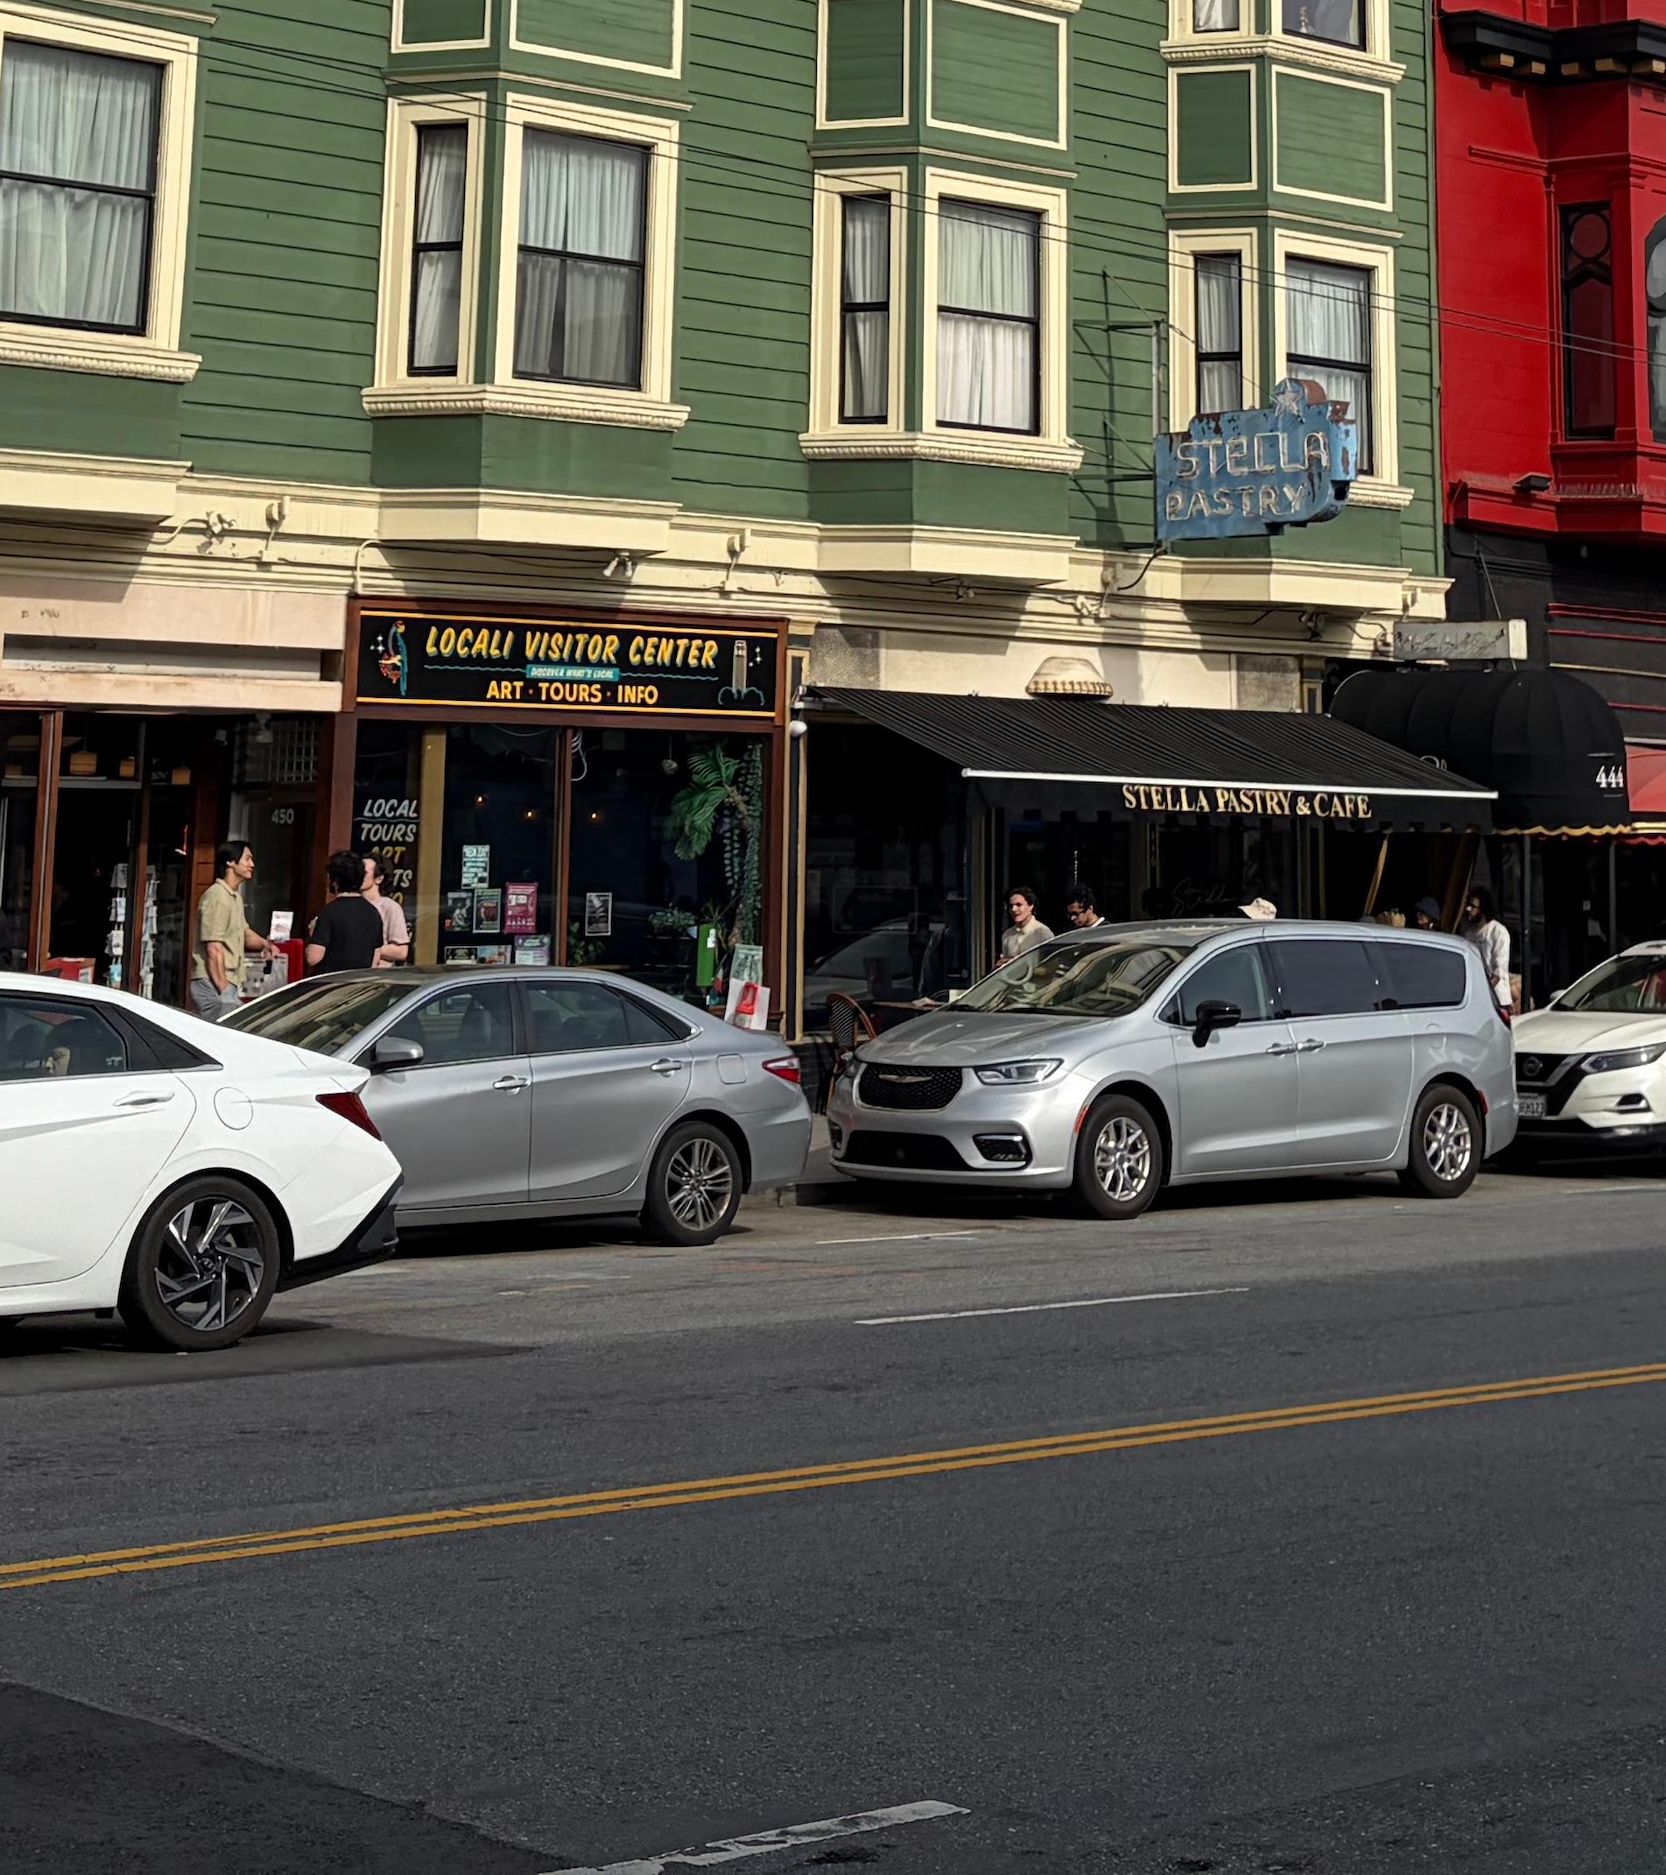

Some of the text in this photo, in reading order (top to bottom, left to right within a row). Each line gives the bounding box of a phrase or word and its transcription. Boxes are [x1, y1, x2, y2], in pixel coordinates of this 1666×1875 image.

[1165, 483, 1308, 522] PASTRY
[425, 626, 720, 670] LOCALI VISITOR CENTER
[486, 680, 659, 705] ART TOURS INFO
[1595, 764, 1624, 789] 444
[363, 798, 419, 818] LOCAL
[1121, 783, 1373, 820] STELLA PASTRY & CAFE
[270, 808, 295, 825] 450
[360, 823, 418, 843] TOURS
